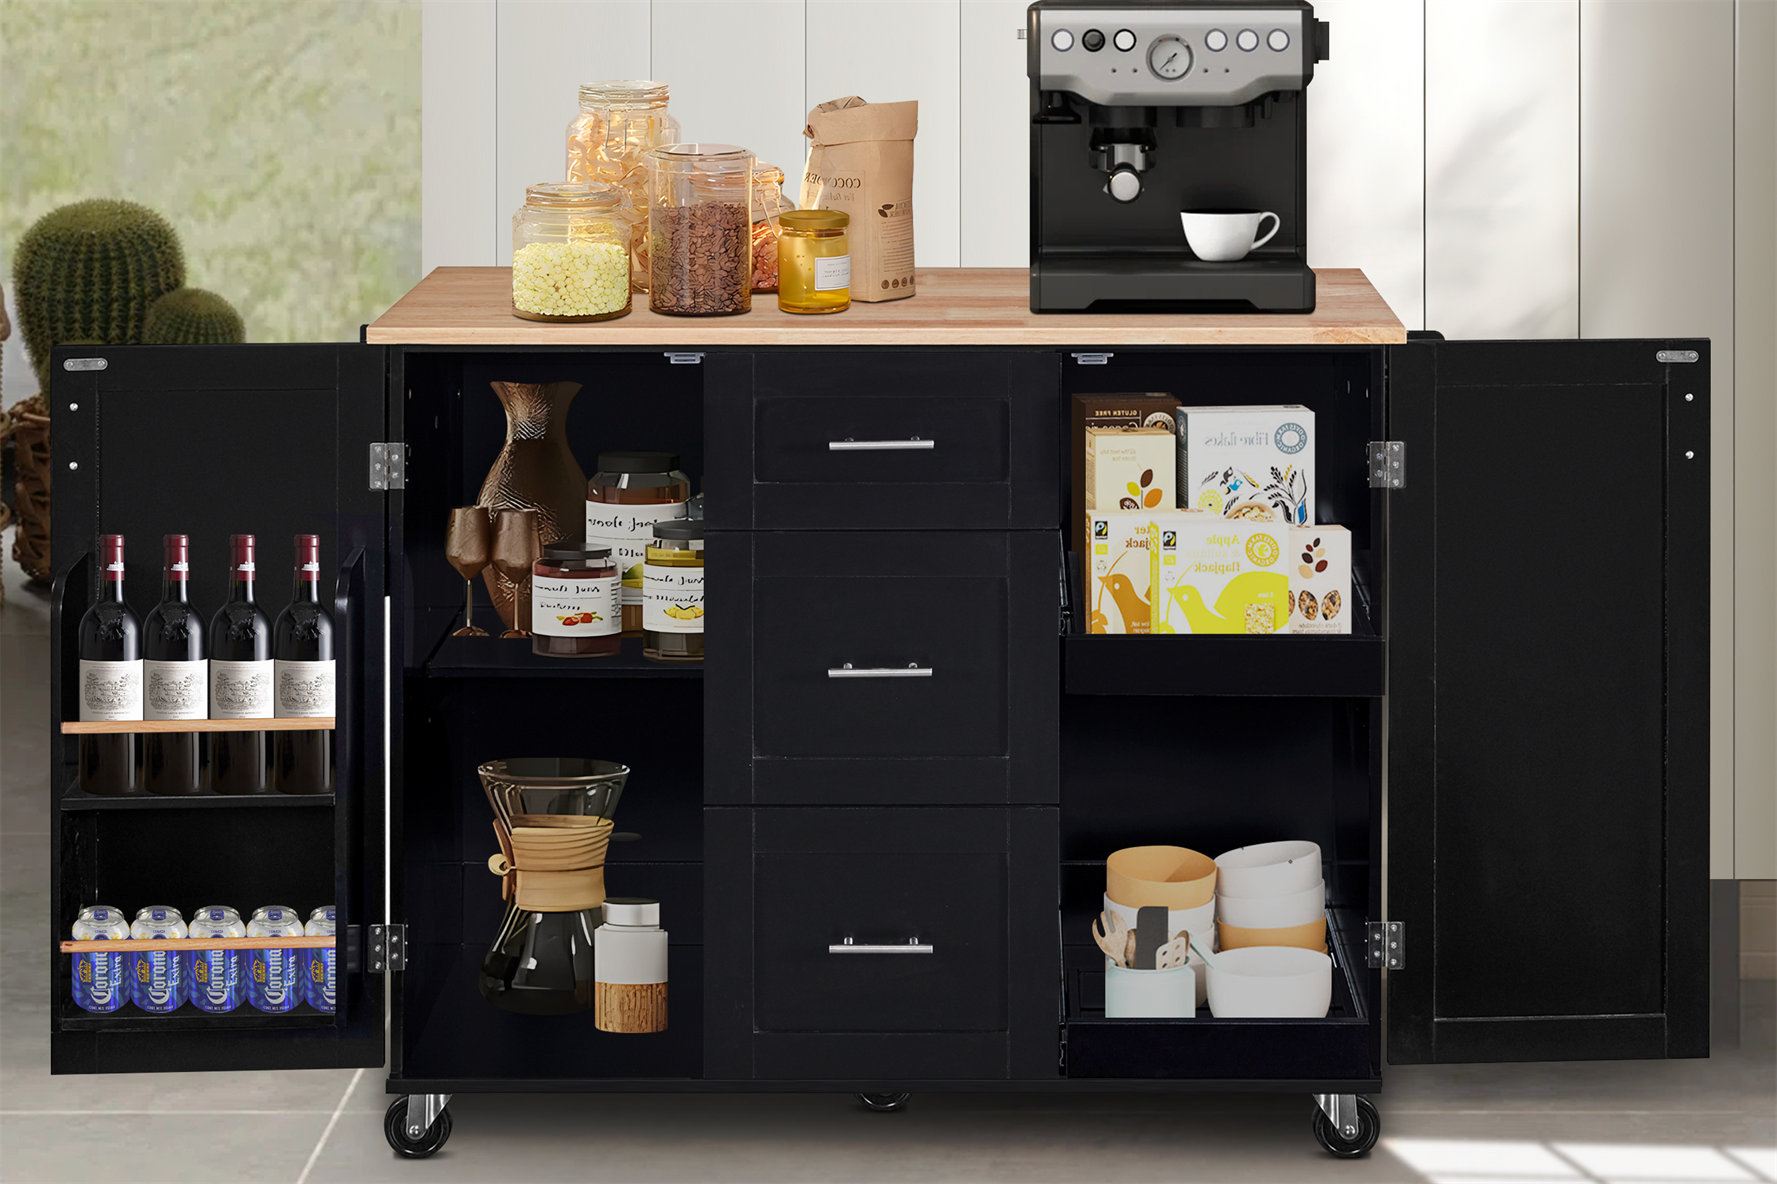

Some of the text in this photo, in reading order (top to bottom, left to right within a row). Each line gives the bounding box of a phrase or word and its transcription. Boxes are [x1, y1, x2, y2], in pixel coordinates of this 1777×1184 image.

[110, 955, 122, 987] Extra
[168, 955, 180, 987] Extra
[226, 955, 238, 987] Extra
[284, 955, 296, 987] Extra
